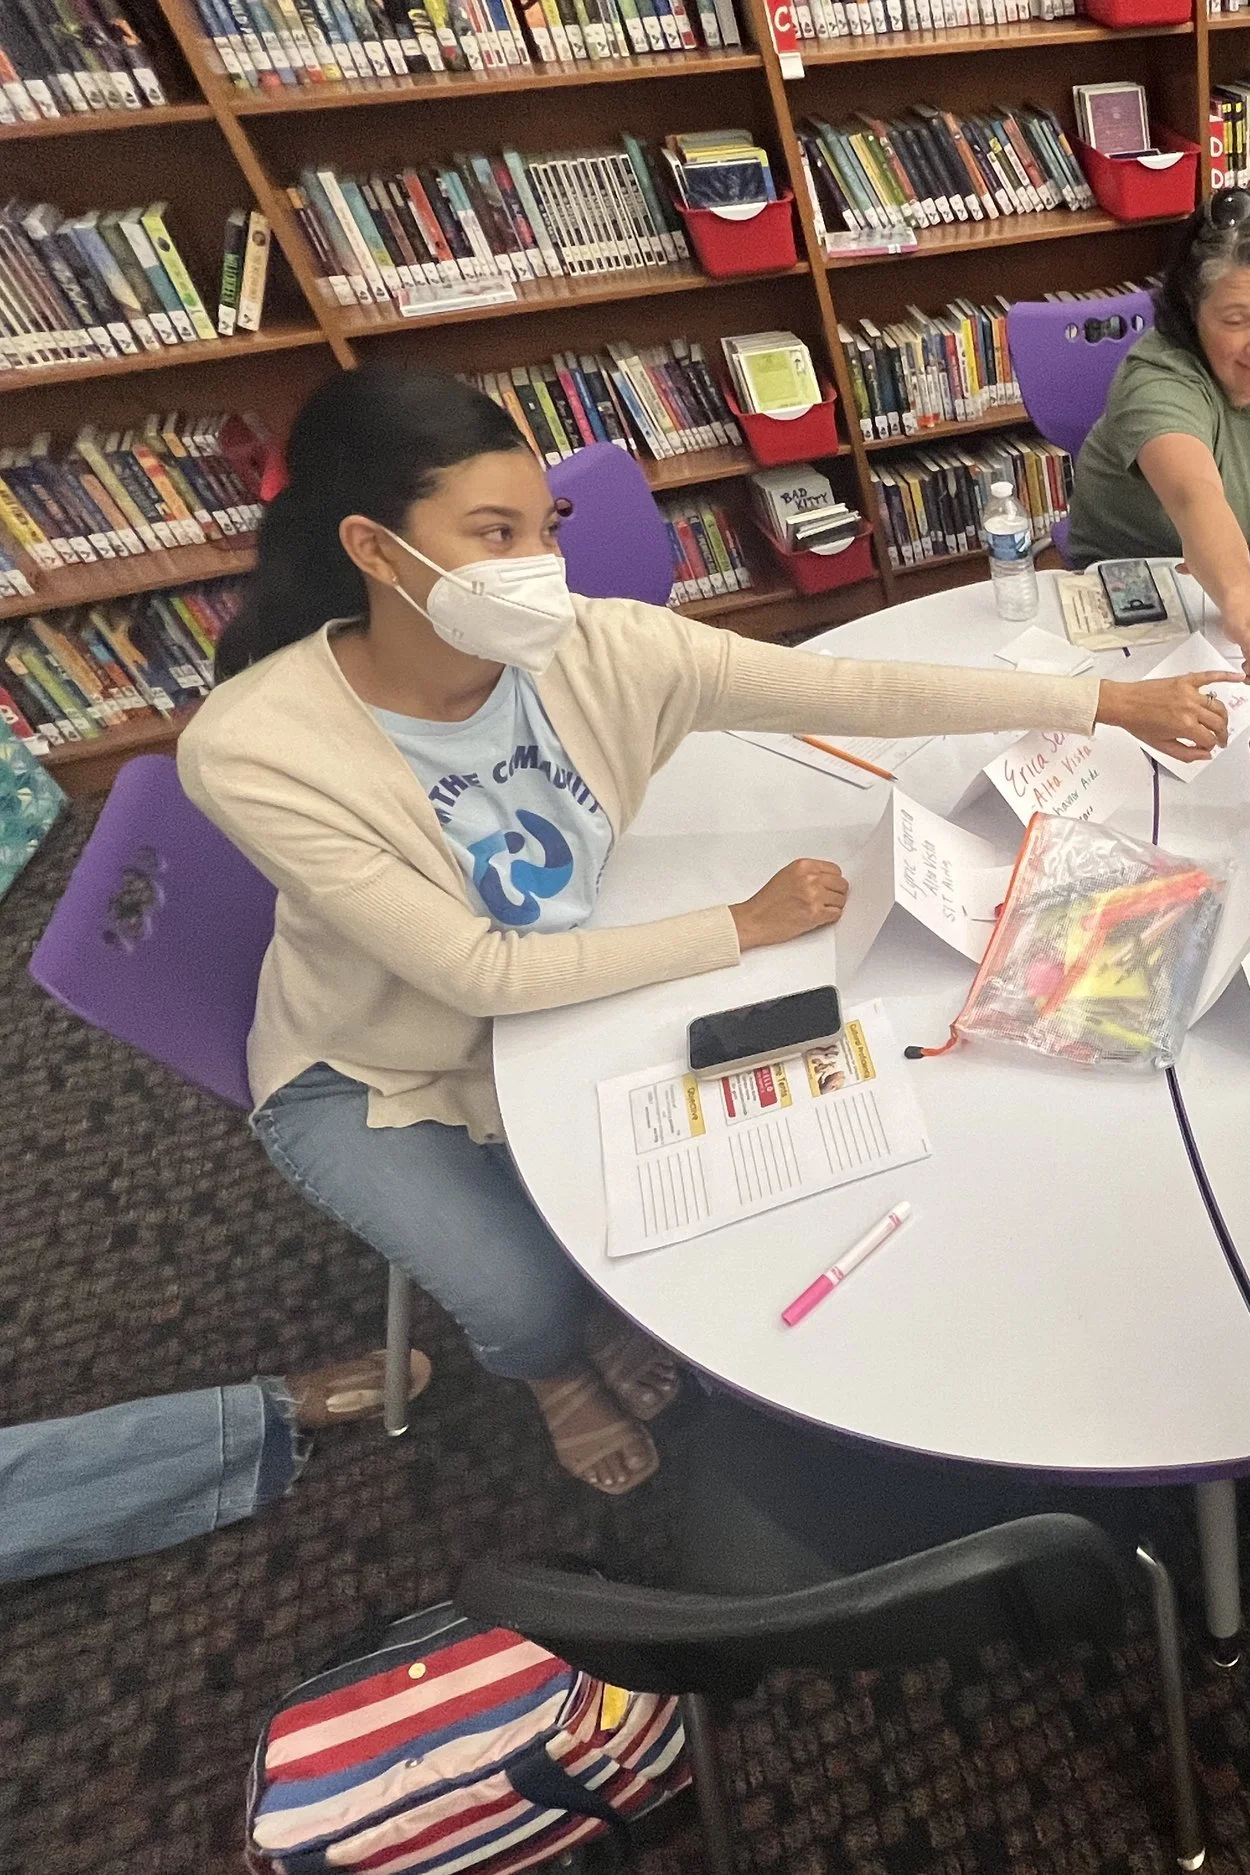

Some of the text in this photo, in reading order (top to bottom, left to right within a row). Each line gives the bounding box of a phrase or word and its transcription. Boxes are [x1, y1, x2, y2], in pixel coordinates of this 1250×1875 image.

[774, 5, 791, 32] C
[1209, 136, 1224, 158] D
[1211, 167, 1224, 189] D
[780, 487, 808, 505] BAD
[795, 492, 829, 511] KITTY
[1004, 730, 1067, 798] Erica Se
[1032, 744, 1092, 808] Alta Vista
[428, 772, 485, 808] THE
[923, 838, 938, 869] Vista
[686, 1086, 699, 1121] Objective
